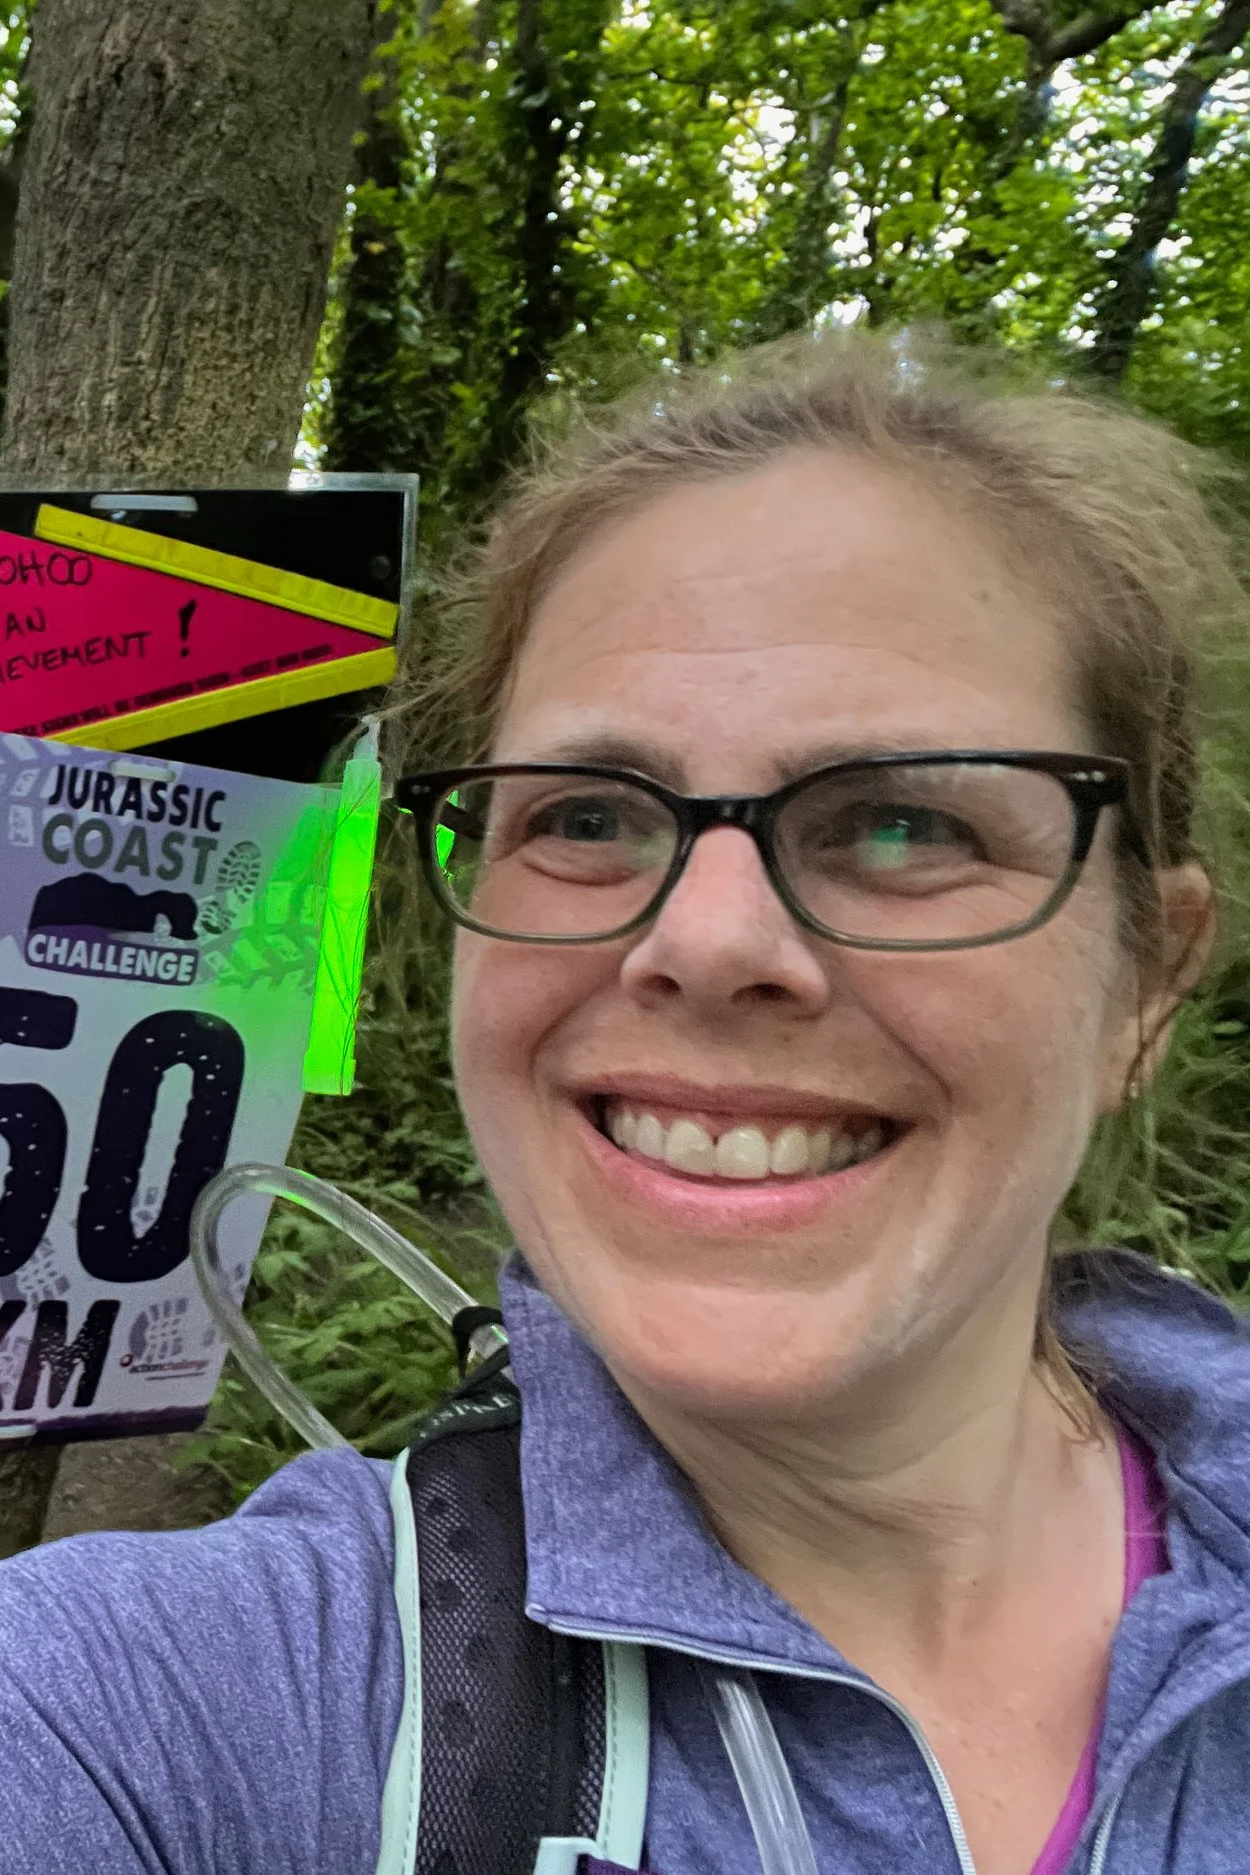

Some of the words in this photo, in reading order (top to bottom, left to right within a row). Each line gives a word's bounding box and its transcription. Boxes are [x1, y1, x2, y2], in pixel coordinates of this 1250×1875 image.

[4, 606, 47, 641] AN
[48, 763, 227, 832] JURASSIC
[41, 813, 221, 885] COAST
[26, 933, 196, 983] CHALLENGE
